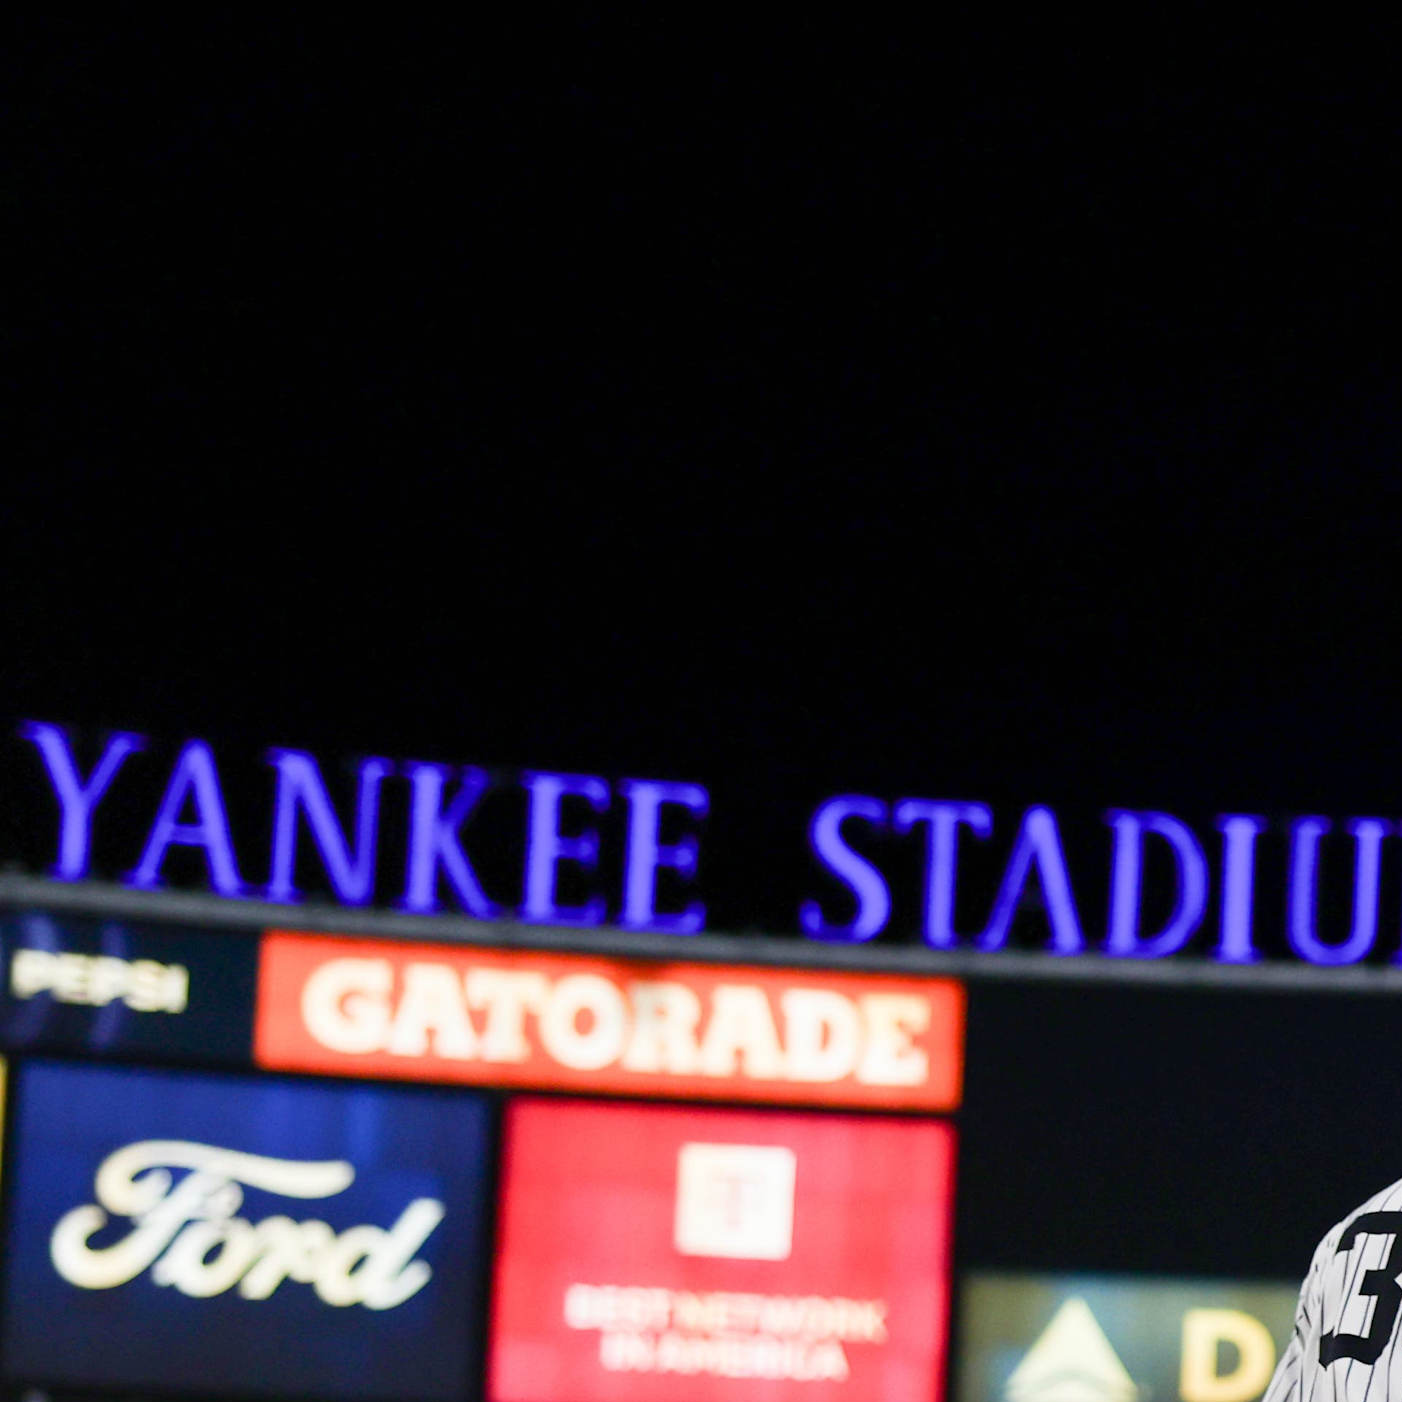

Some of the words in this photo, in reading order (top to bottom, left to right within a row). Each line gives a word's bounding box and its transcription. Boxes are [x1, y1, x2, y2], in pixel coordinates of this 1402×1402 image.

[18, 719, 709, 935] YANKEE
[10, 948, 190, 1014] PEPSI
[300, 958, 931, 1087] GATORADE
[49, 1139, 445, 1311] Ford
